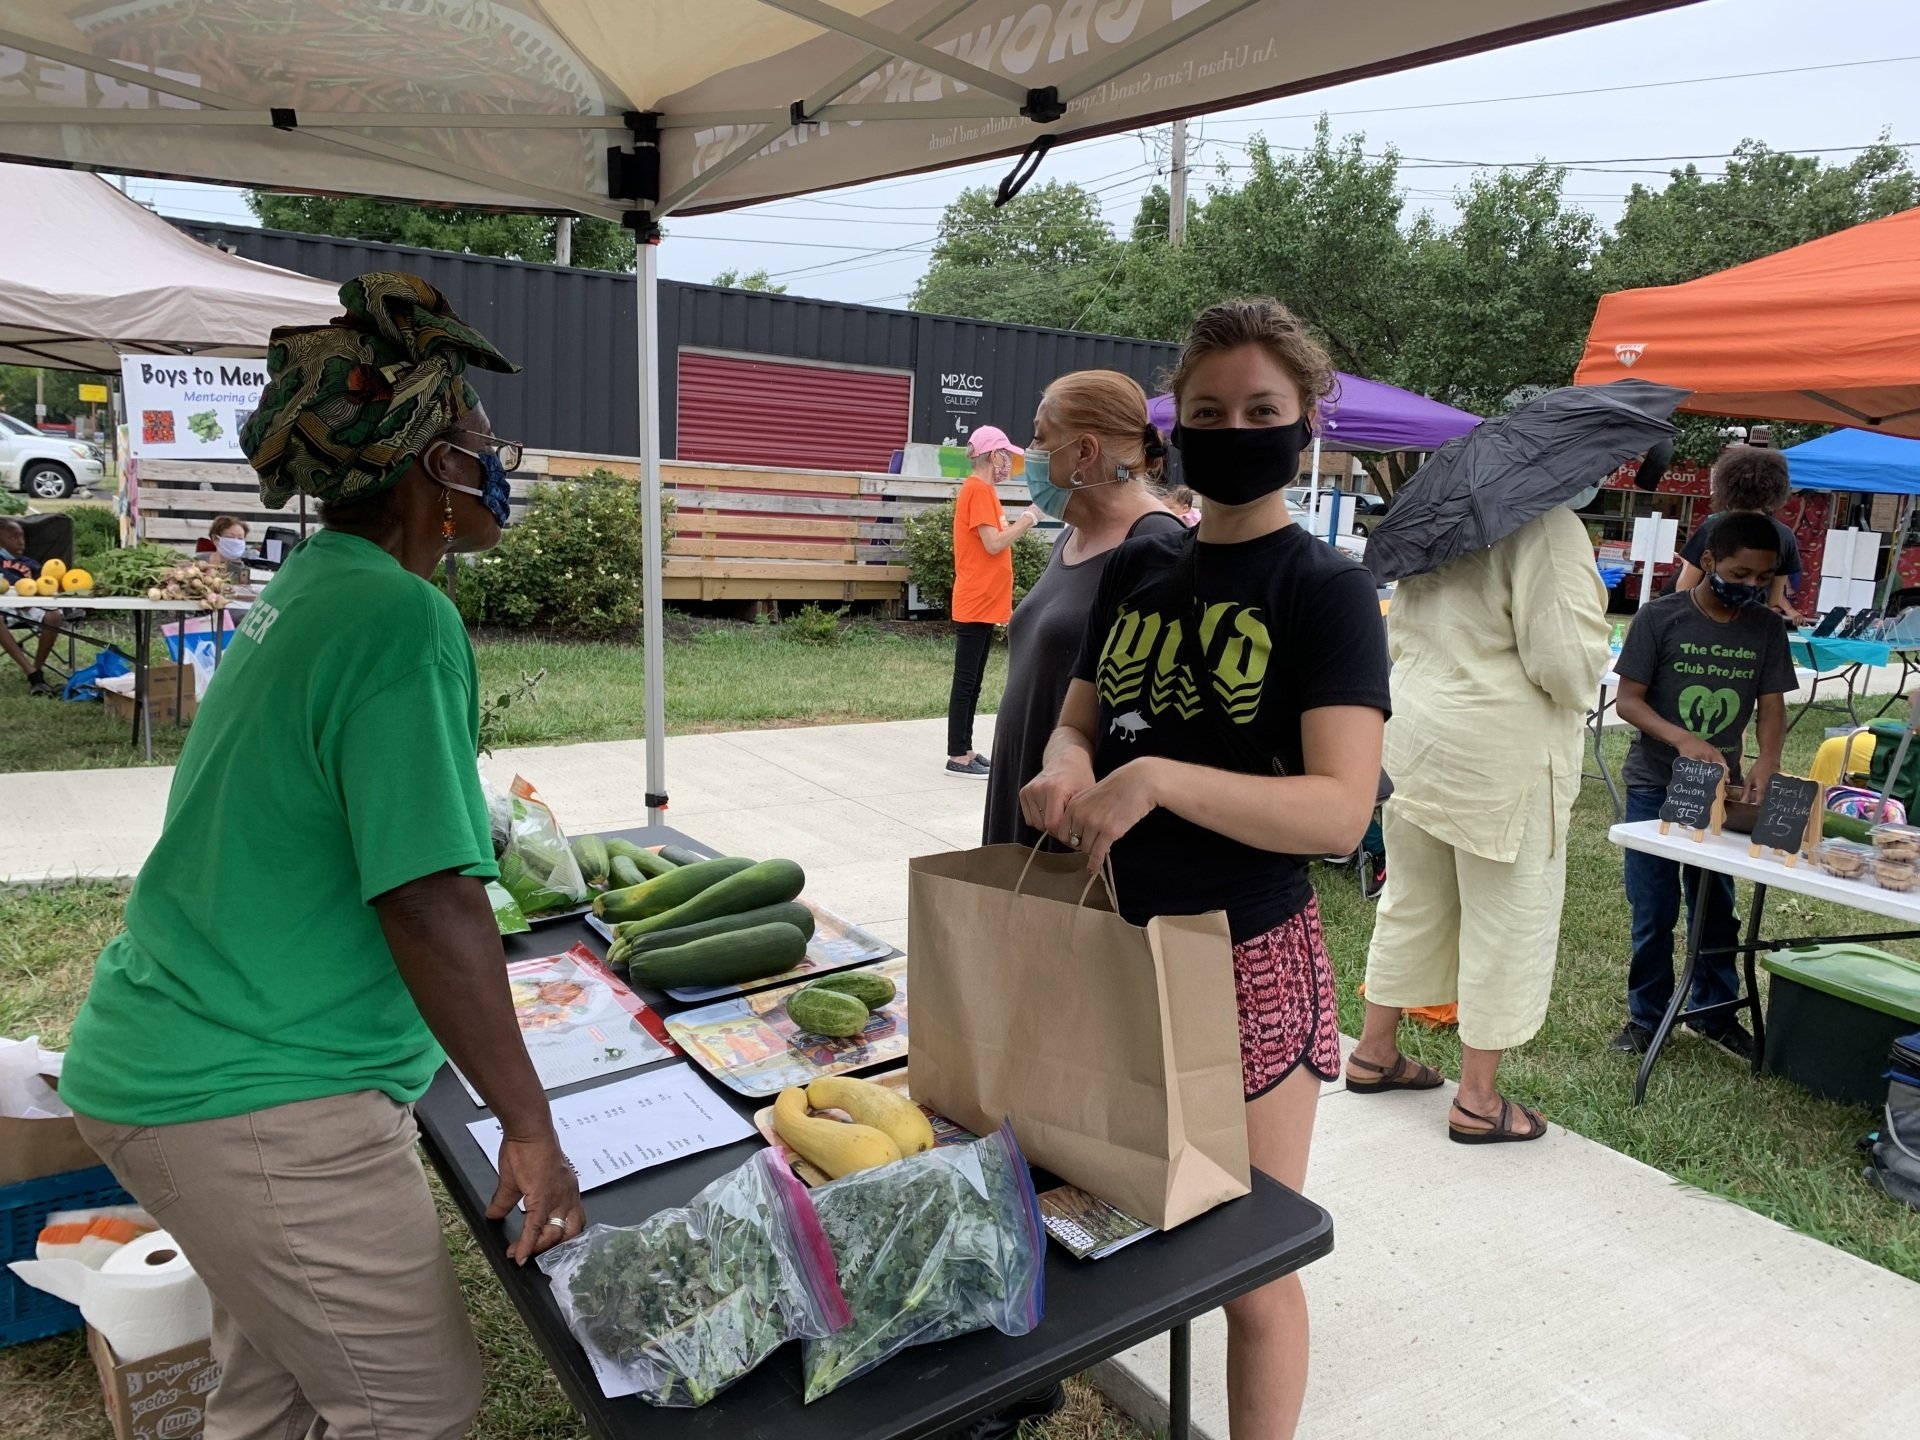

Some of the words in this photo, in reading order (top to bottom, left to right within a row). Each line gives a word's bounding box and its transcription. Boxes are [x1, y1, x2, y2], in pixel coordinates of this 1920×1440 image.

[141, 364, 188, 388] Boys
[193, 367, 214, 386] to
[220, 366, 265, 387] Men
[184, 391, 246, 405] Mentoring
[944, 395, 980, 407] GALLERY
[1680, 643, 1708, 655] The
[1711, 644, 1757, 660] Garden
[1673, 661, 1705, 675] Club
[1707, 664, 1755, 680] Project
[1673, 783, 1706, 798] Onion
[1771, 780, 1809, 801] Fresh
[130, 1388, 178, 1418] eetos
